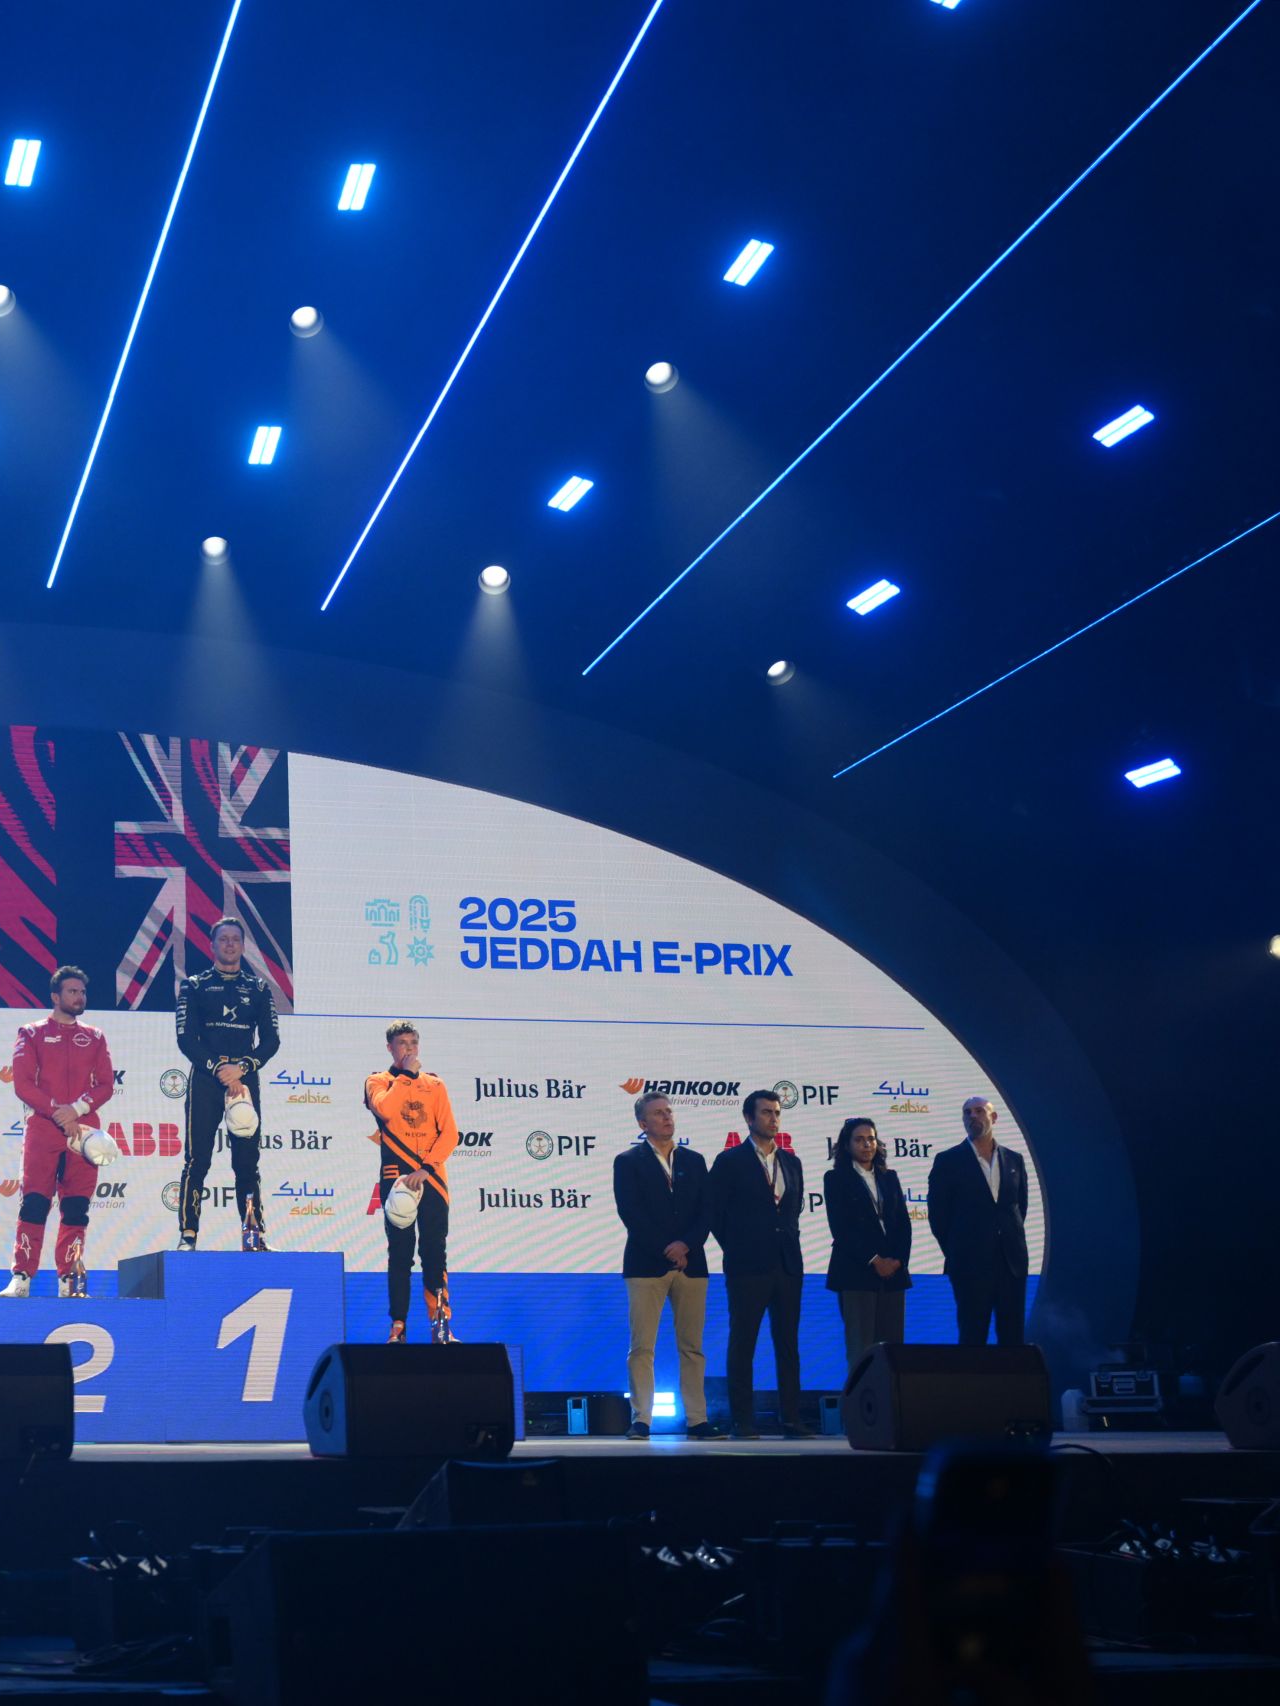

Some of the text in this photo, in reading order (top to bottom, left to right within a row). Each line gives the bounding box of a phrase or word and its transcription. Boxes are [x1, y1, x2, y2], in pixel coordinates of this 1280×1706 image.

[459, 897, 577, 933] 2025
[460, 936, 793, 976] JEDDAH E-PRIX
[475, 1077, 587, 1101] Julius Bär
[802, 1085, 839, 1105] PIF
[106, 1122, 182, 1156] ABB
[290, 1129, 332, 1150] Bär
[558, 1135, 596, 1156] PIF
[894, 1137, 932, 1158] Bär
[89, 1200, 125, 1209] motion
[201, 1187, 236, 1207] PIF
[479, 1188, 591, 1212] Julius Bär
[216, 1288, 293, 1401] 1
[44, 1323, 114, 1412] 2
